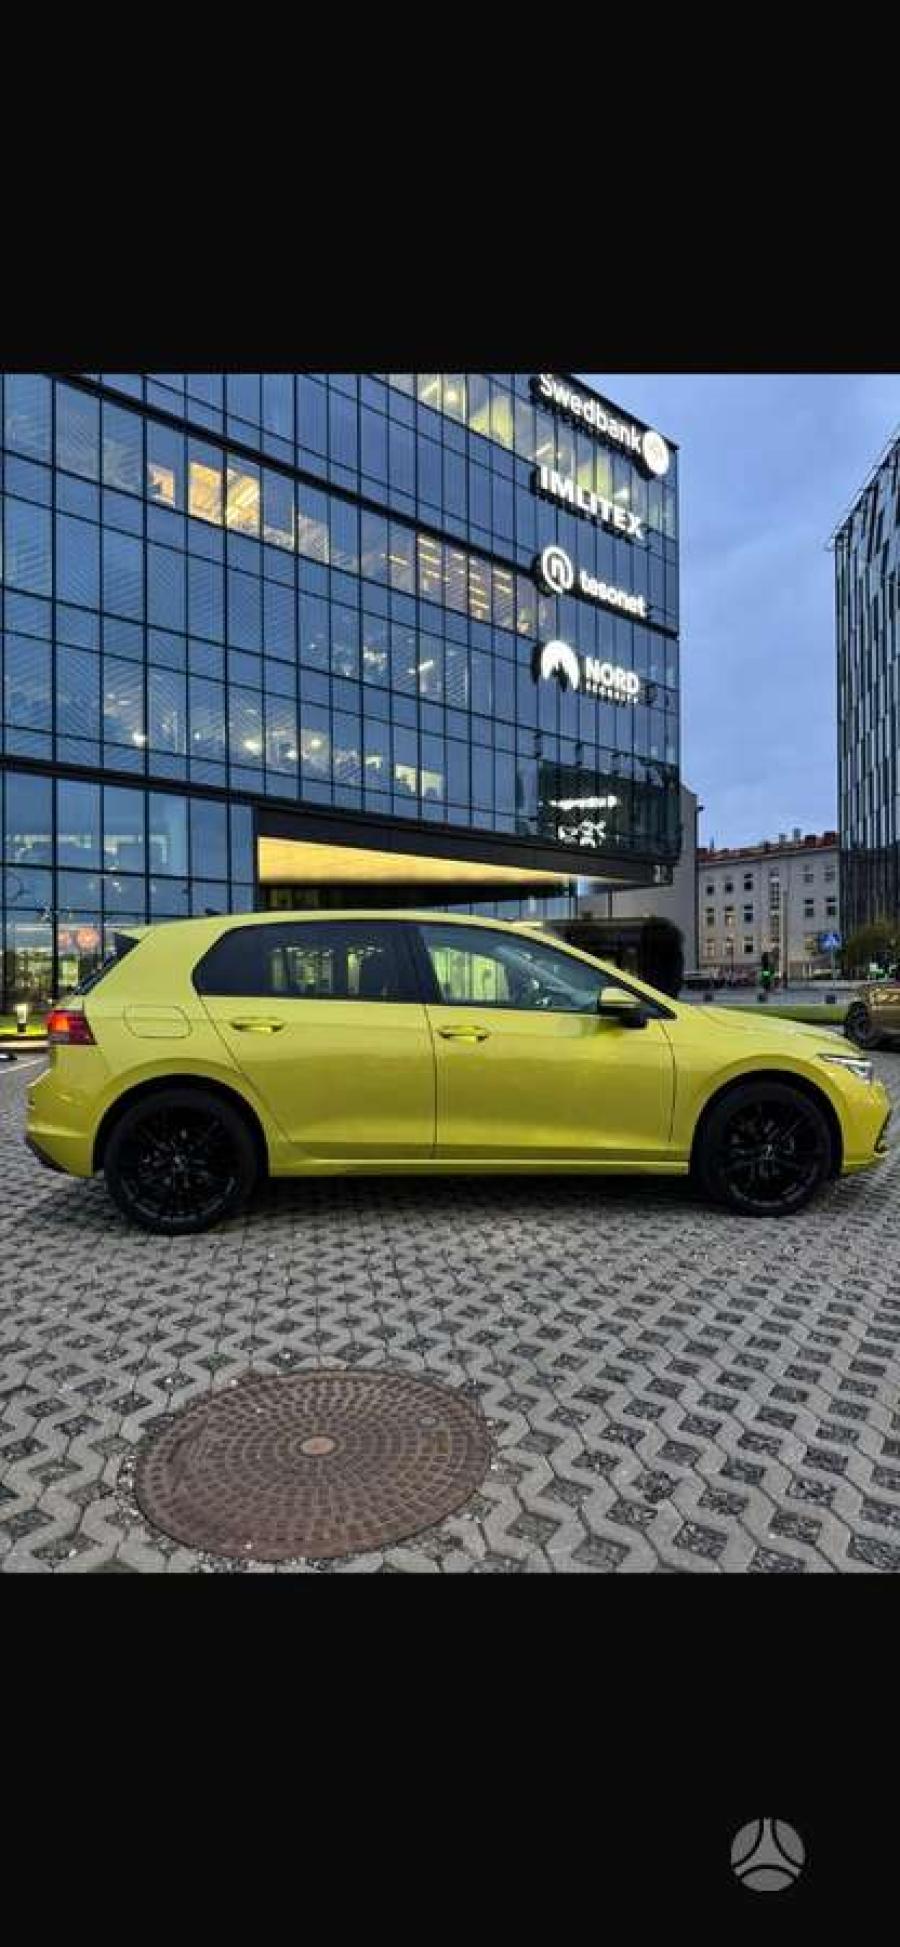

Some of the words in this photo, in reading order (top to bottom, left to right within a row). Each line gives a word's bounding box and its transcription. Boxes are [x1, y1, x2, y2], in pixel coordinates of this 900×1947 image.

[540, 374, 641, 454] Swedbank
[541, 466, 645, 540] IMLITEX
[579, 570, 647, 618] tesonet
[585, 657, 639, 694] NORD
